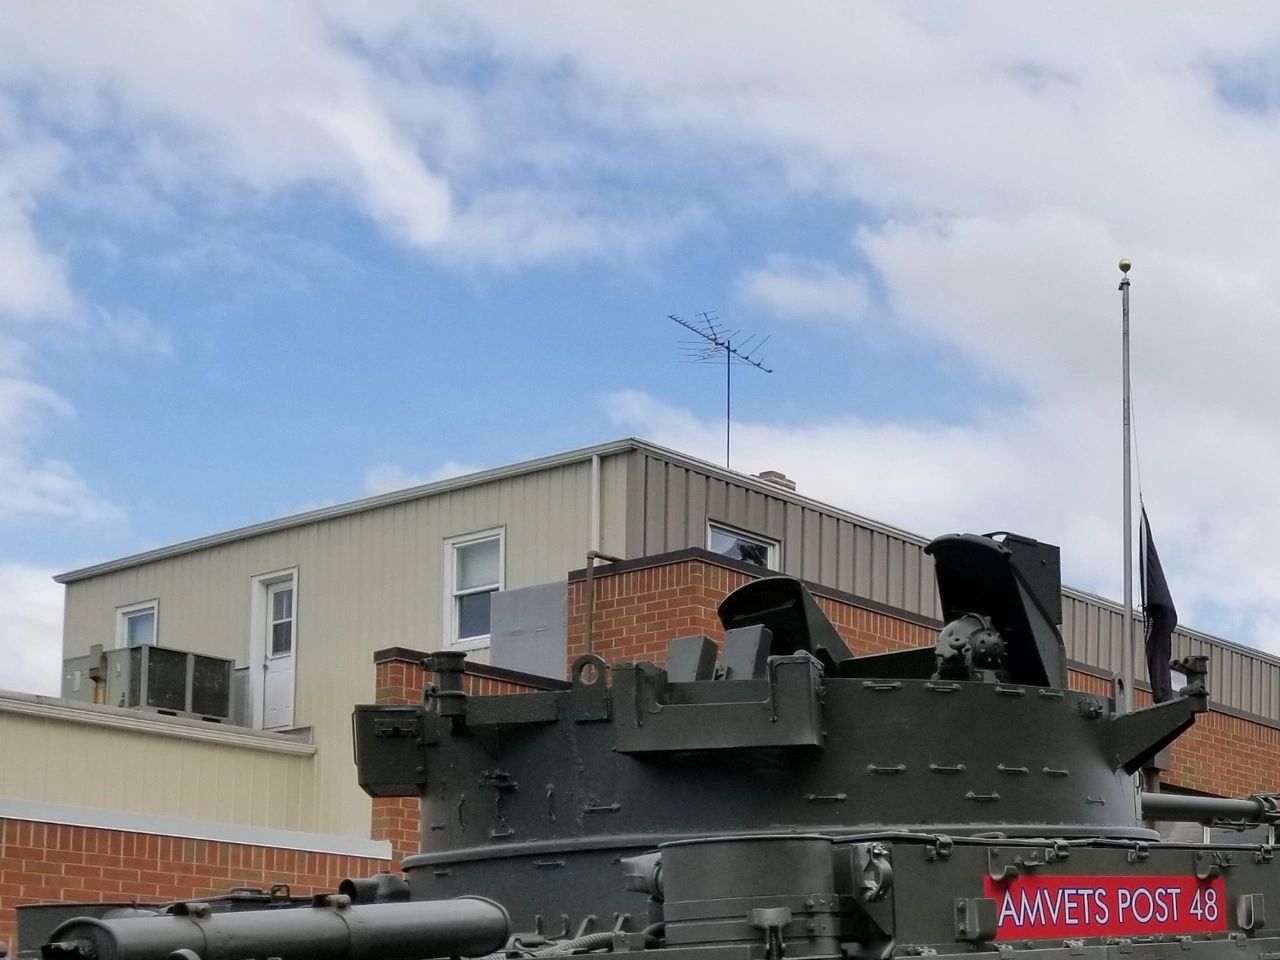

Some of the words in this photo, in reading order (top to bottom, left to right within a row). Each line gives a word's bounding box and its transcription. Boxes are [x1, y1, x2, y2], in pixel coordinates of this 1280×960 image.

[997, 887, 1110, 927] AMVETS
[1118, 887, 1182, 924] POST
[1188, 887, 1219, 922] 48
